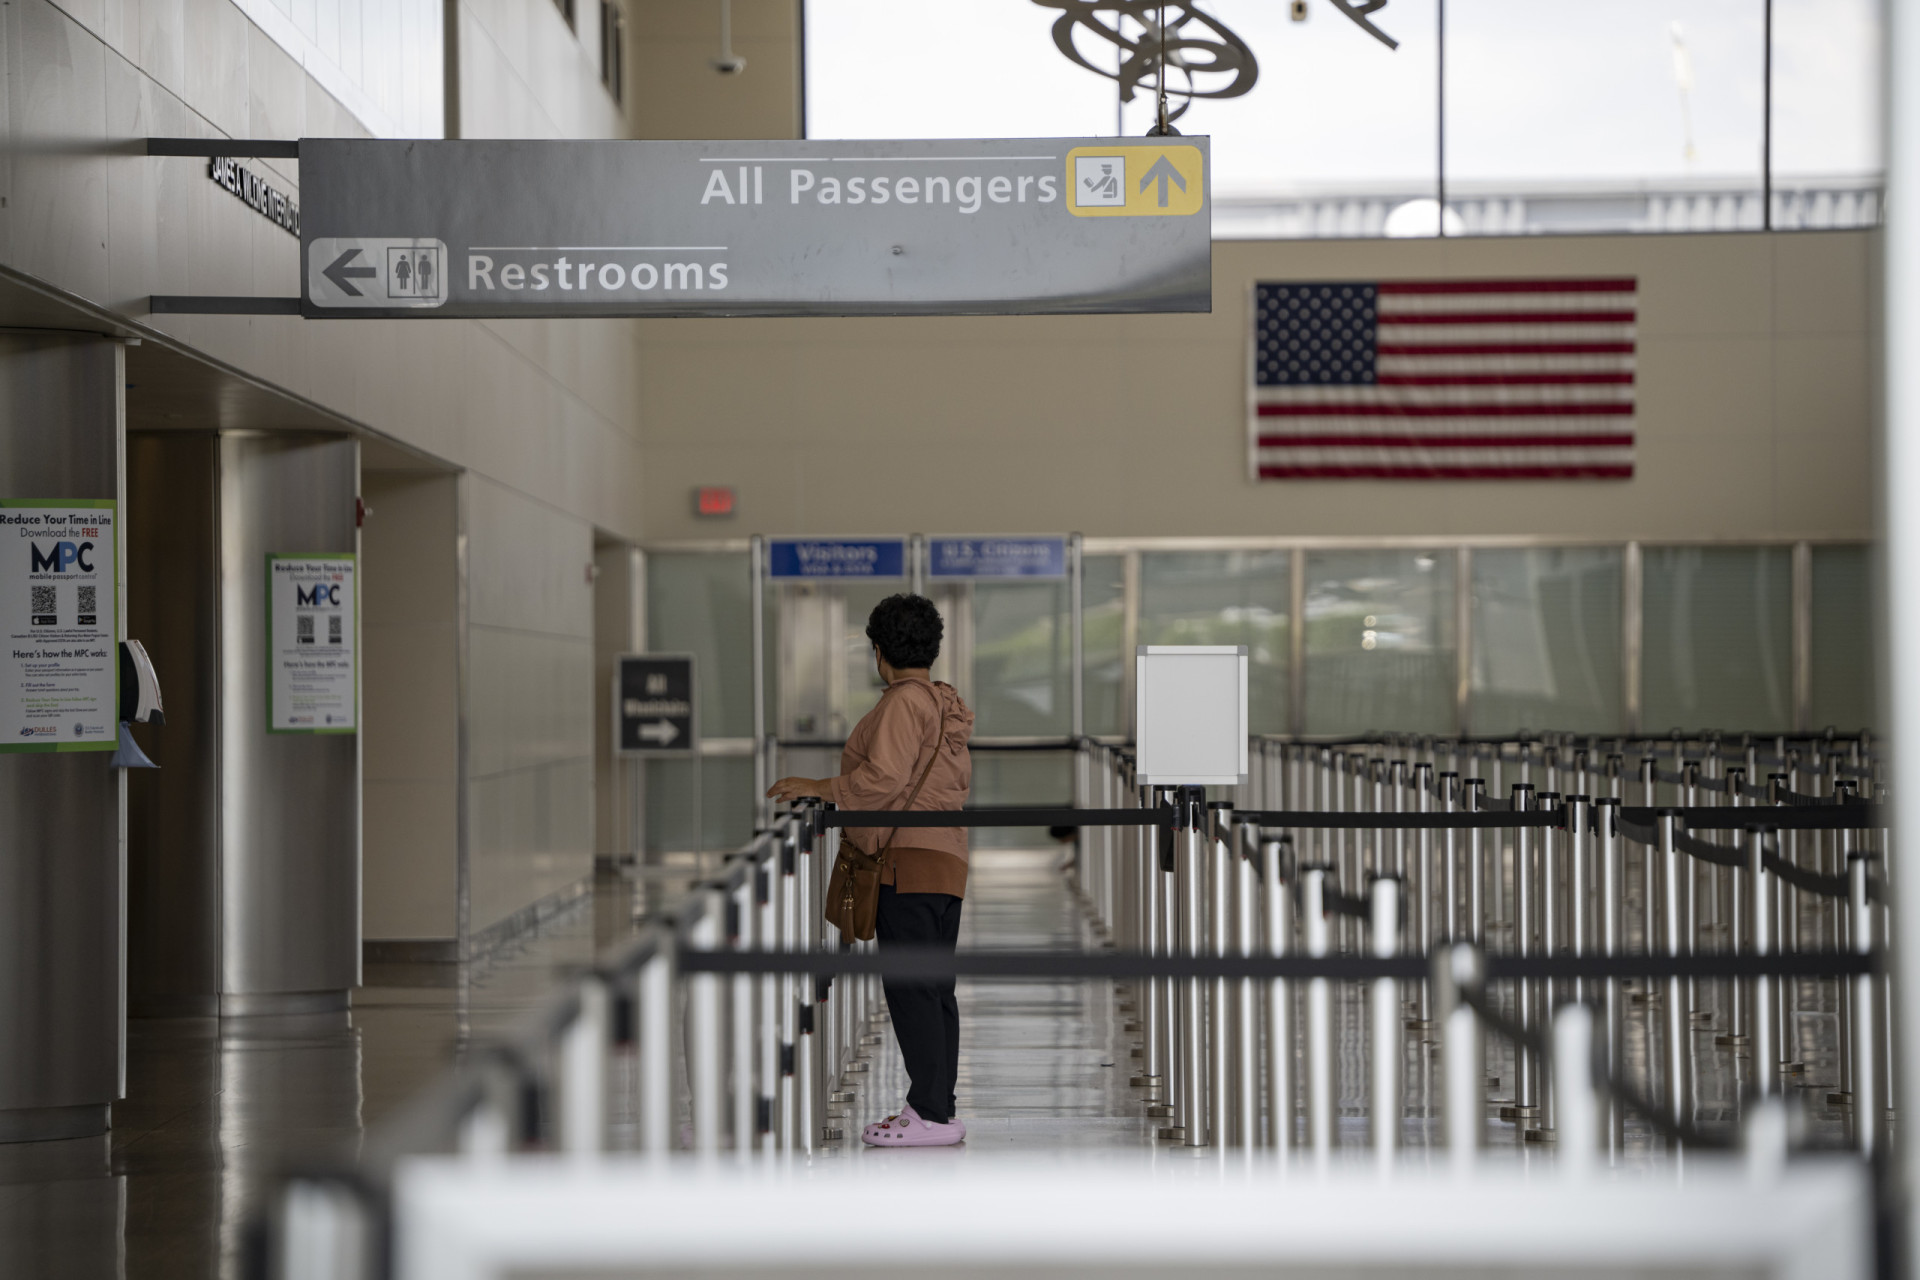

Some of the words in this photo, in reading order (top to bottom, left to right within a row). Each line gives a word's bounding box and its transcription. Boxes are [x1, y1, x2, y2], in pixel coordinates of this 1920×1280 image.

[700, 166, 763, 205] All
[790, 168, 1057, 214] Passengers
[468, 254, 729, 291] Restrooms
[0, 514, 40, 525] Reduce
[43, 514, 67, 525] Your
[69, 514, 88, 525] Time
[90, 514, 97, 525] in
[98, 514, 111, 526] Line
[20, 527, 67, 538] Download
[68, 527, 80, 538] the
[81, 527, 99, 538] FREE
[31, 541, 95, 573] MPC
[29, 573, 52, 581] mobile
[52, 573, 78, 582] passport
[297, 583, 341, 606] MPC
[13, 650, 41, 659] Here's
[42, 649, 62, 658] how
[61, 649, 73, 658] the
[74, 648, 90, 658] MPC
